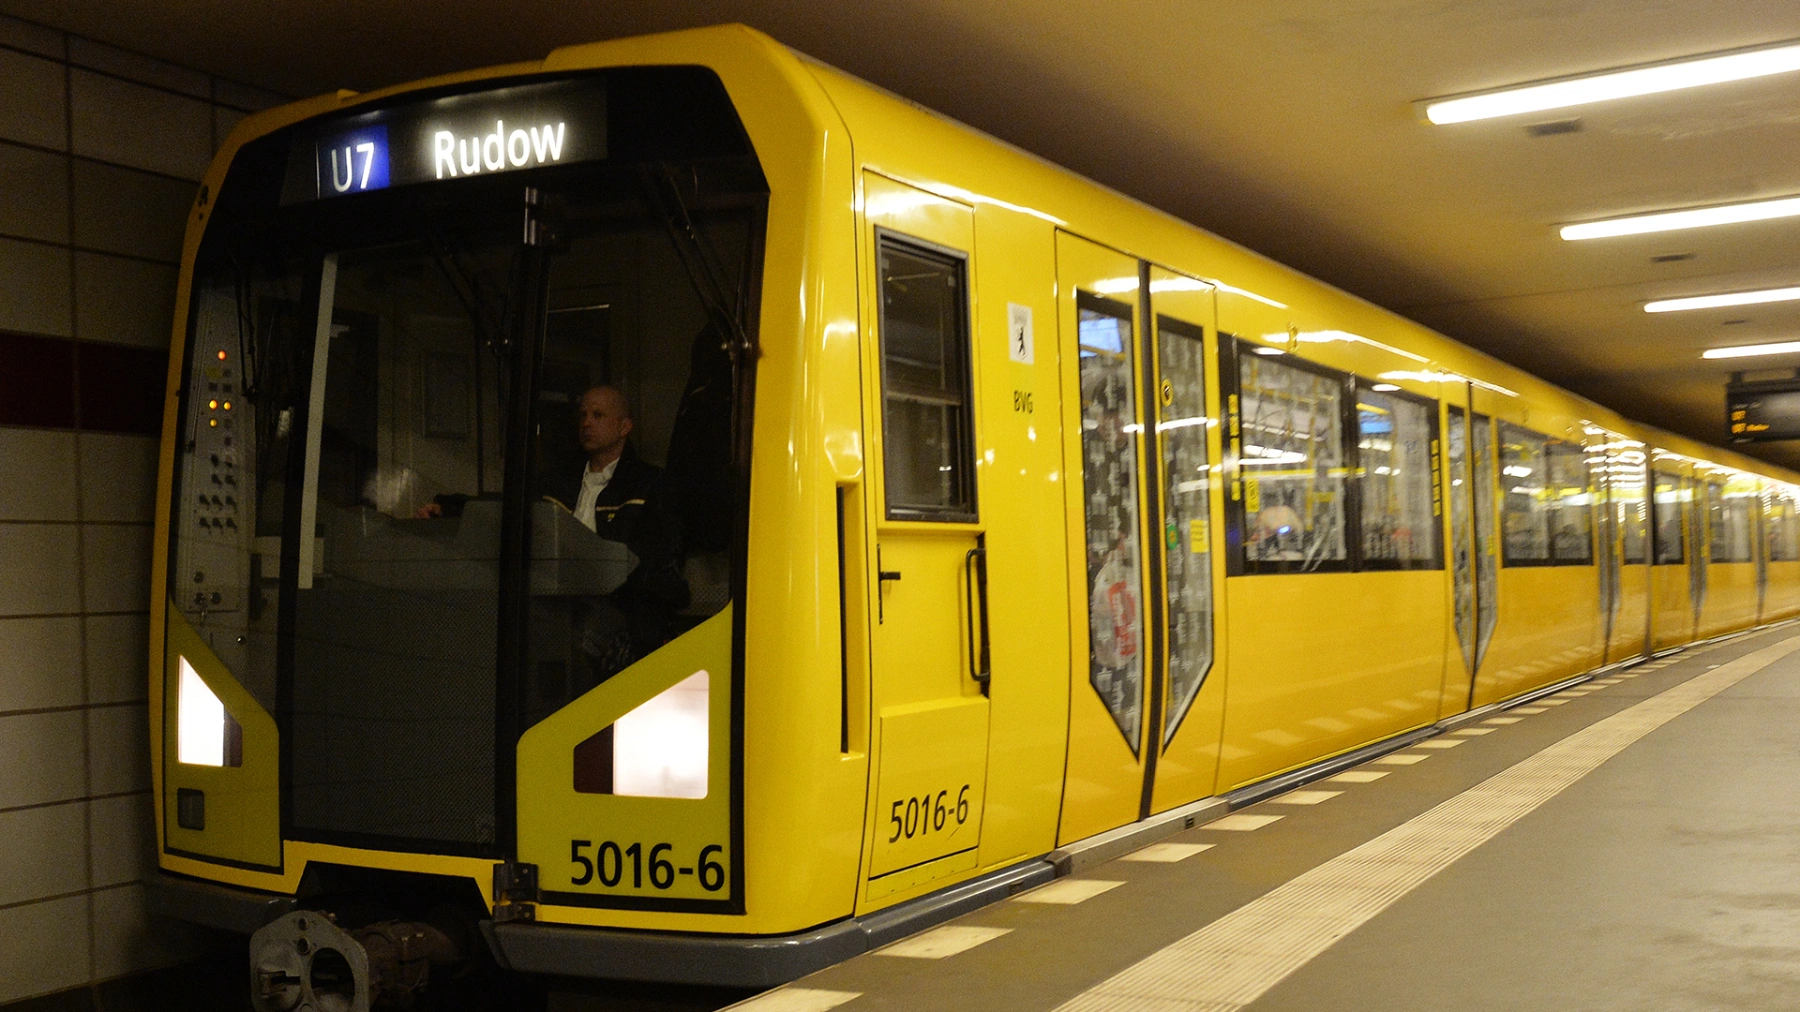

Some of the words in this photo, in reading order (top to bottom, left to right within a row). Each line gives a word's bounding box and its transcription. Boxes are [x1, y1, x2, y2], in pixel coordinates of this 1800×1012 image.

[331, 142, 375, 193] U7
[434, 119, 566, 180] Rudow
[1013, 390, 1034, 414] BVG
[888, 784, 970, 844] 5016-6
[570, 839, 725, 892] 5016-6
